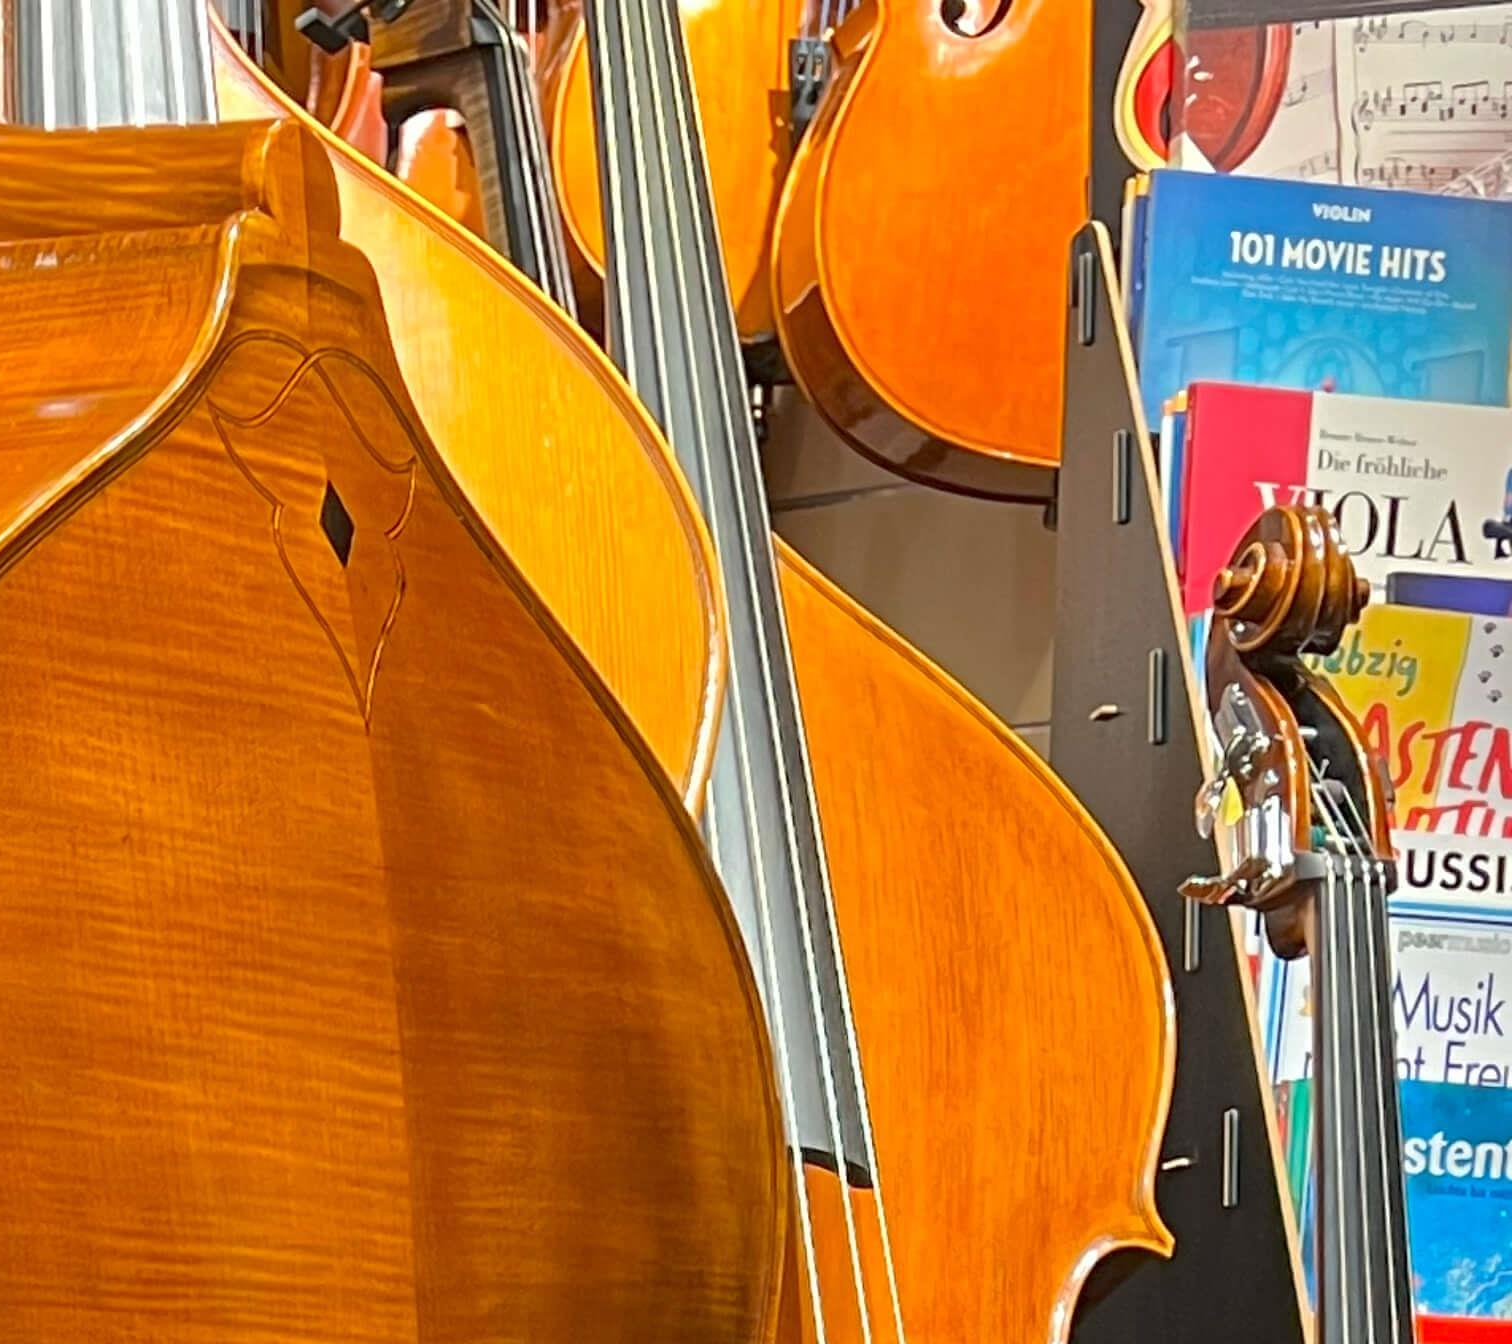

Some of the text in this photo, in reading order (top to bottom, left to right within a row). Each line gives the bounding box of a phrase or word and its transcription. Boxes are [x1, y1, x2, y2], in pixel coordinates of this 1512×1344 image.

[1312, 203, 1371, 223] VIOLIN
[1230, 230, 1447, 283] 101 MOVIE HITS
[1317, 449, 1448, 481] Die fröhliche
[1406, 849, 1512, 894] USSI
[1393, 969, 1506, 1037] Musik
